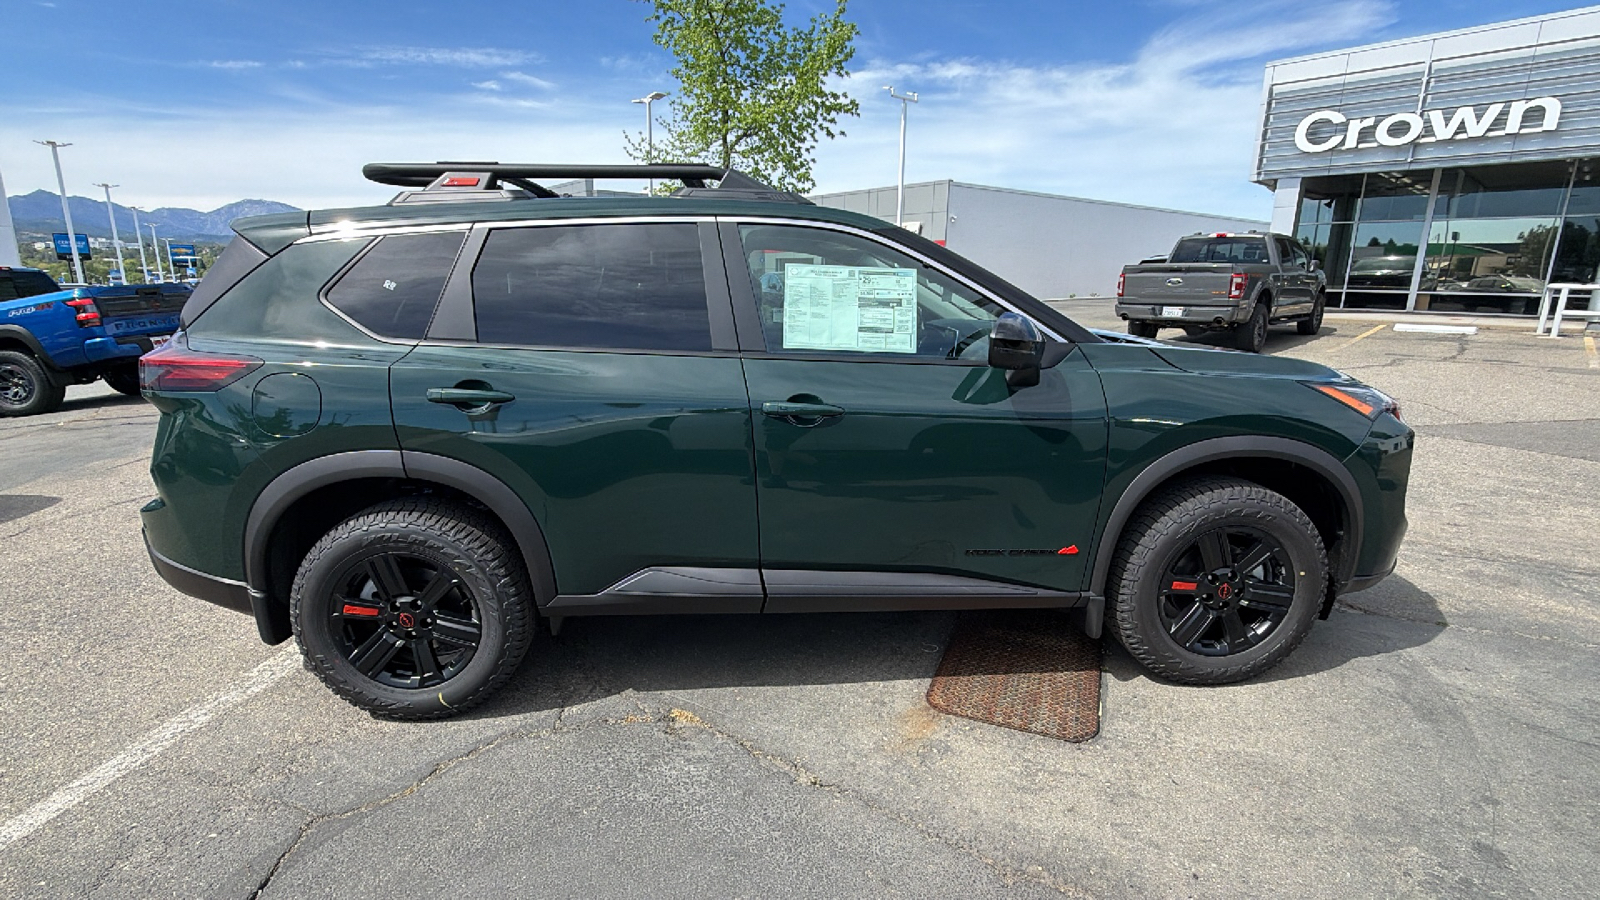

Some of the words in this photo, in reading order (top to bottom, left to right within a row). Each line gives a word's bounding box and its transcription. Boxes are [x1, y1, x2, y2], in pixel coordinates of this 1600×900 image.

[1294, 96, 1562, 153] Crown
[114, 317, 180, 331] FRONTI
[965, 548, 1007, 556] ROCK
[1008, 548, 1057, 556] CREEK
